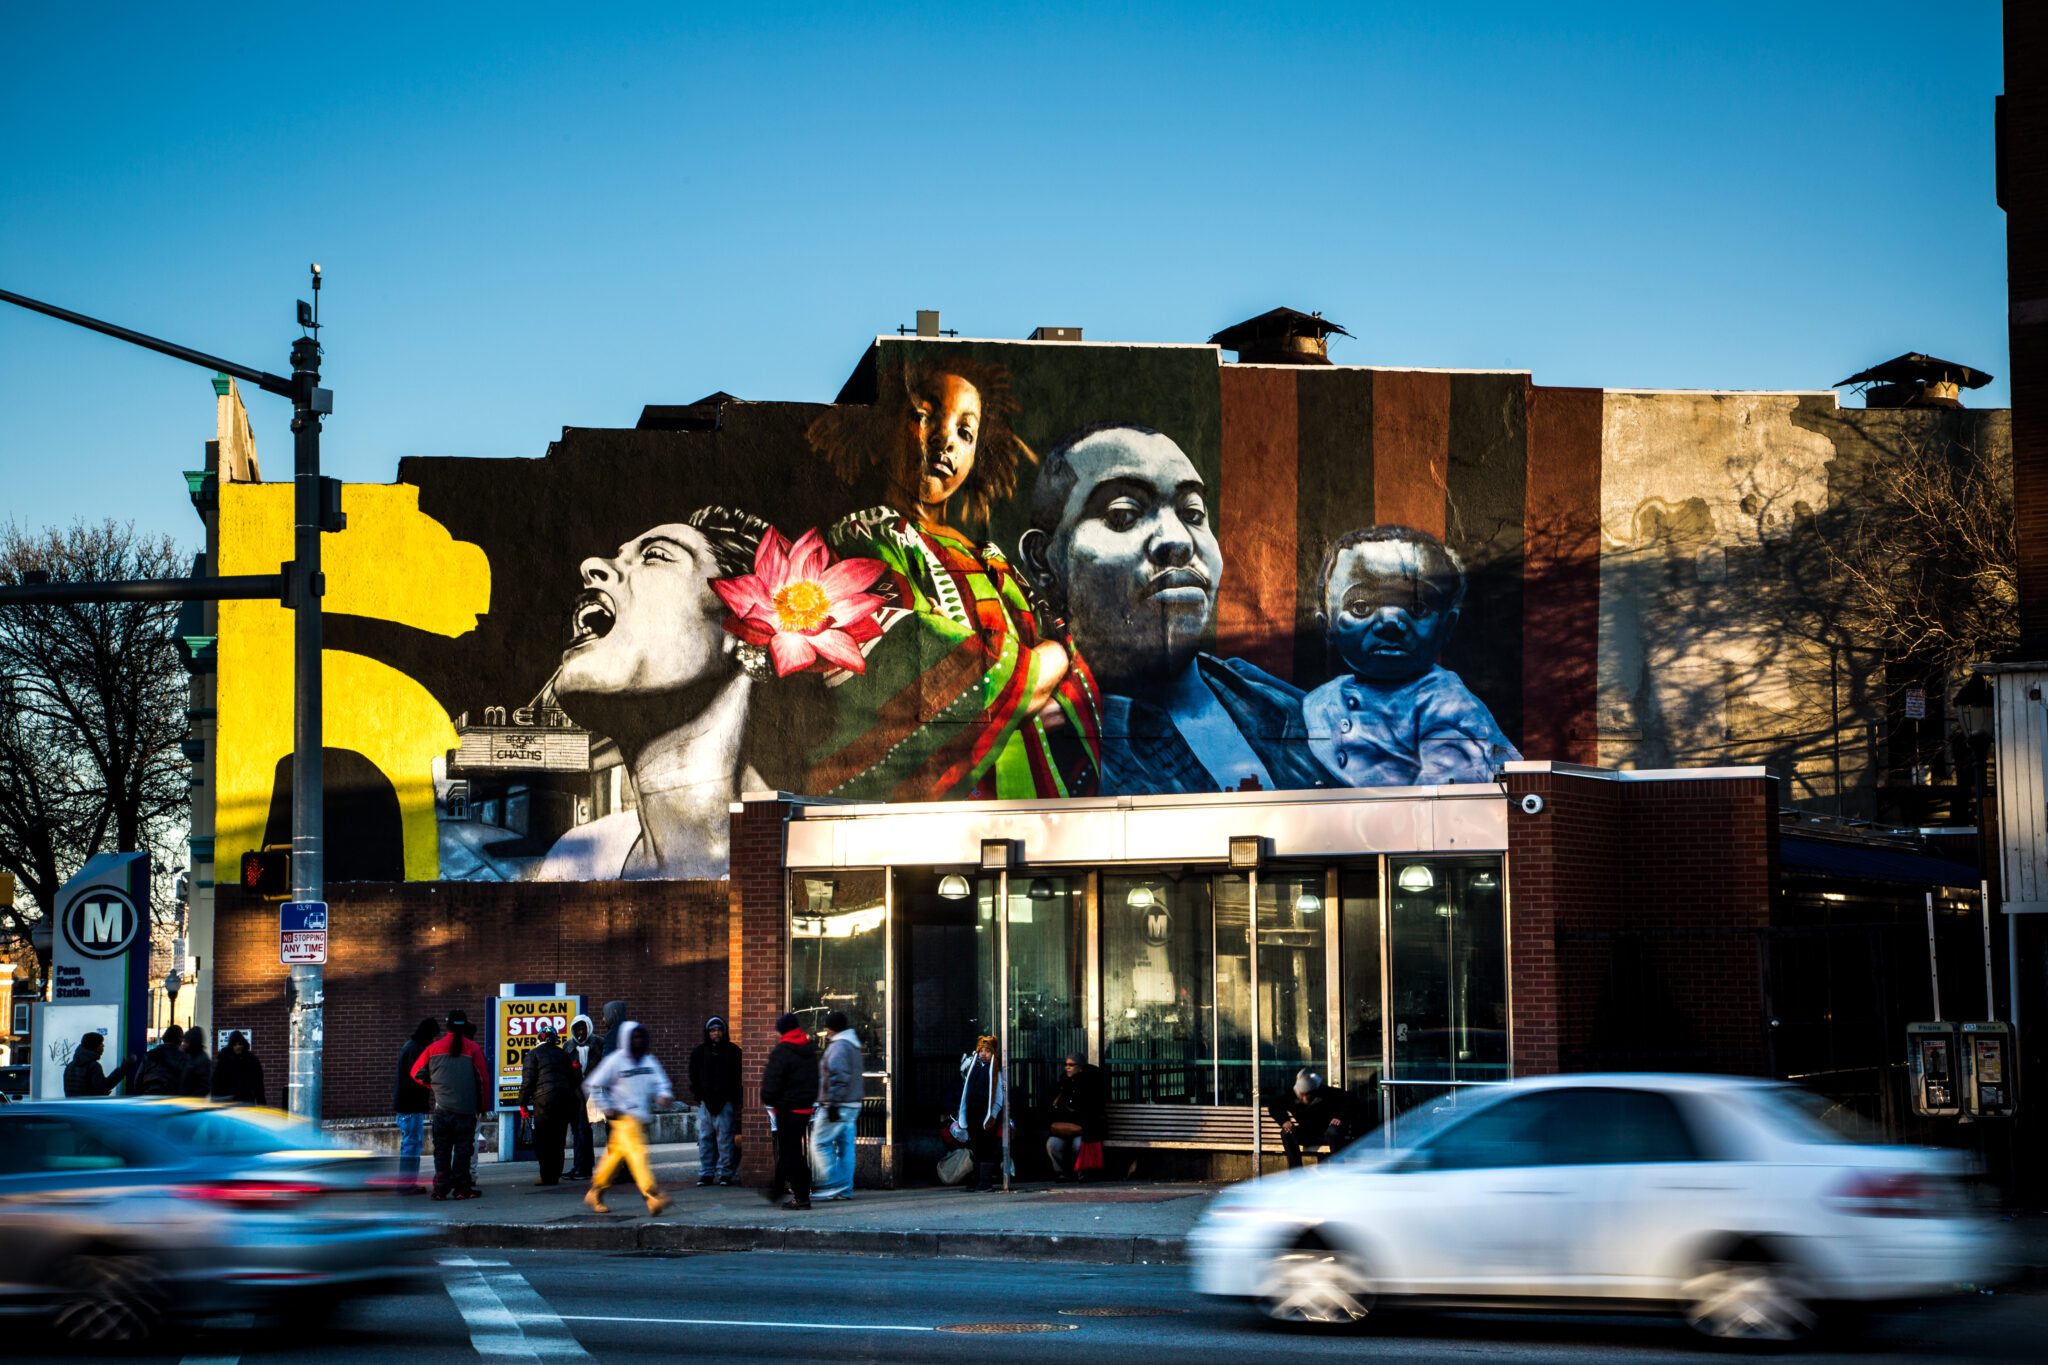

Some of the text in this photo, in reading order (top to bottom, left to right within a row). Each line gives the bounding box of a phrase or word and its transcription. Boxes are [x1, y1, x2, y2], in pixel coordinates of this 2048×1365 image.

[505, 735, 536, 744] BREAK
[496, 749, 542, 761] CHAINS
[83, 902, 123, 943] M
[283, 934, 324, 942] NO STOPPING
[284, 944, 324, 953] ANY TIME
[56, 965, 81, 976] Penn
[56, 976, 85, 986] North
[56, 987, 91, 998] Station
[507, 1002, 568, 1015] YOU CAN
[508, 1016, 566, 1036] STOP
